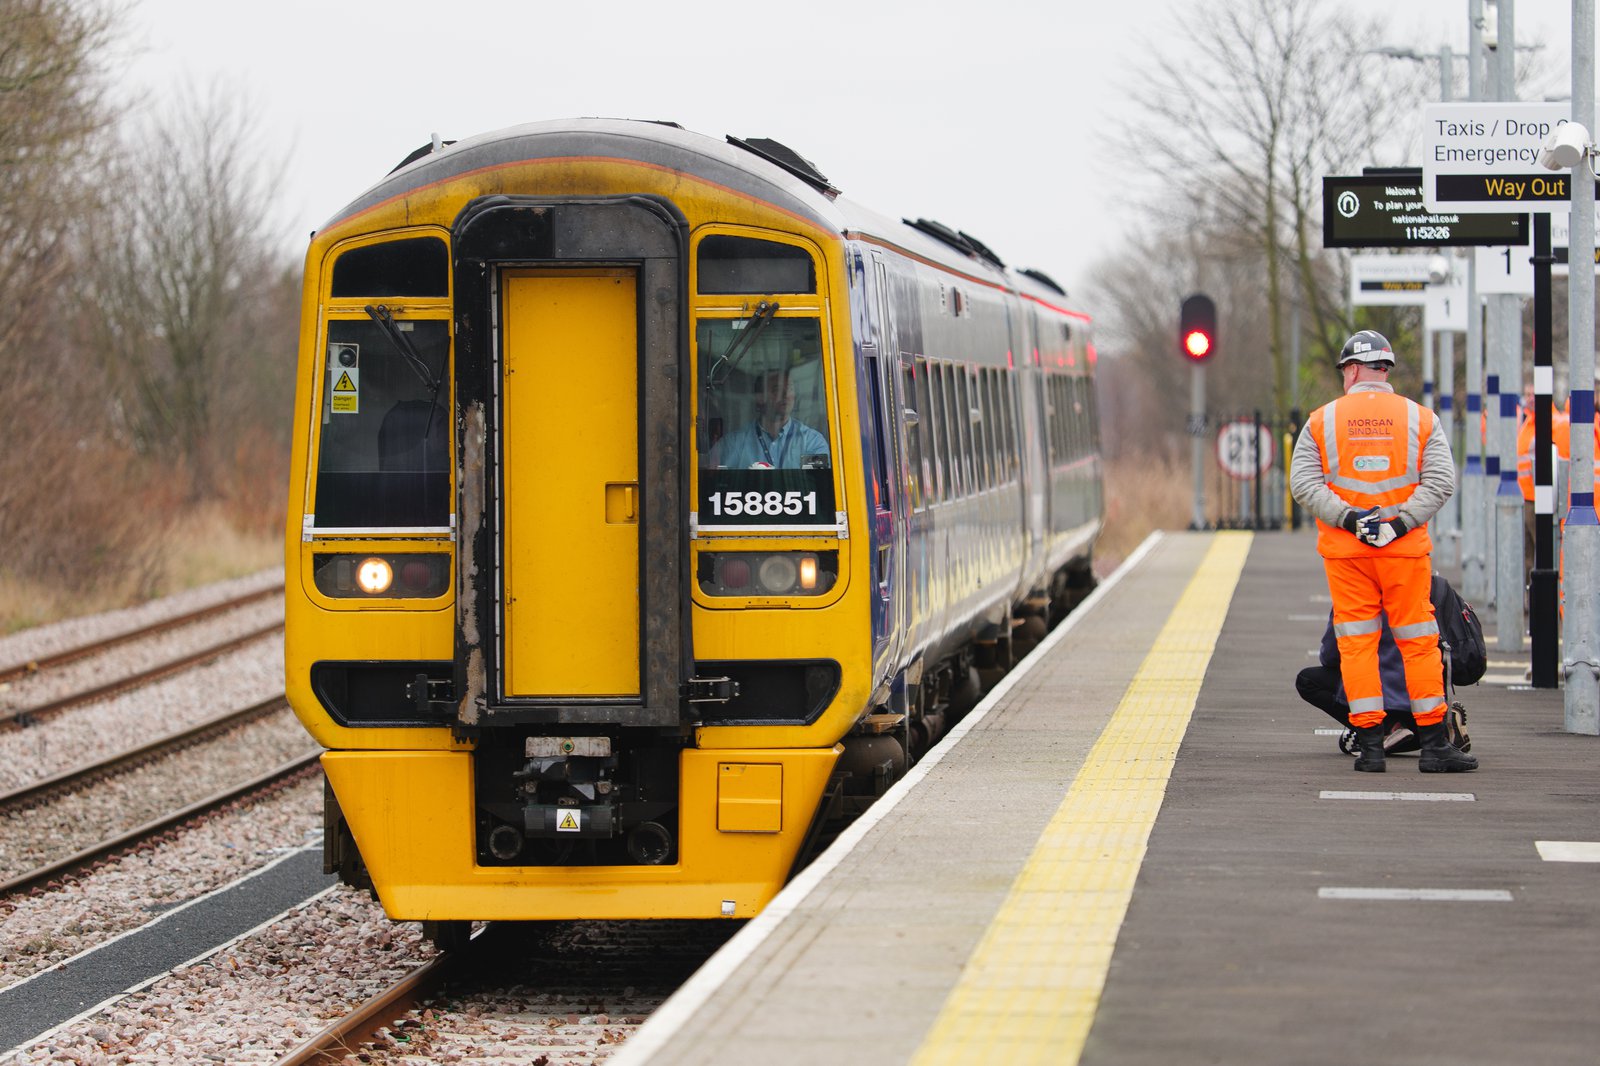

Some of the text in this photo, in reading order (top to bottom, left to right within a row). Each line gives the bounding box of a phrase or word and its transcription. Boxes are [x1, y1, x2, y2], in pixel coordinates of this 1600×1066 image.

[1435, 119, 1485, 136] Taxis
[1490, 119, 1499, 137] /
[1505, 119, 1550, 139] Drop
[1434, 145, 1540, 166] Emergency
[1385, 186, 1417, 196] Welcome
[1485, 178, 1565, 200] Way Out
[1373, 200, 1384, 210] To
[1385, 200, 1404, 212] plan
[1392, 214, 1460, 224] nationalrail.co.uk
[1502, 248, 1511, 275] 1
[1347, 418, 1393, 427] MORGAN
[1347, 427, 1391, 436] SINDALL
[708, 491, 817, 516] 158851
